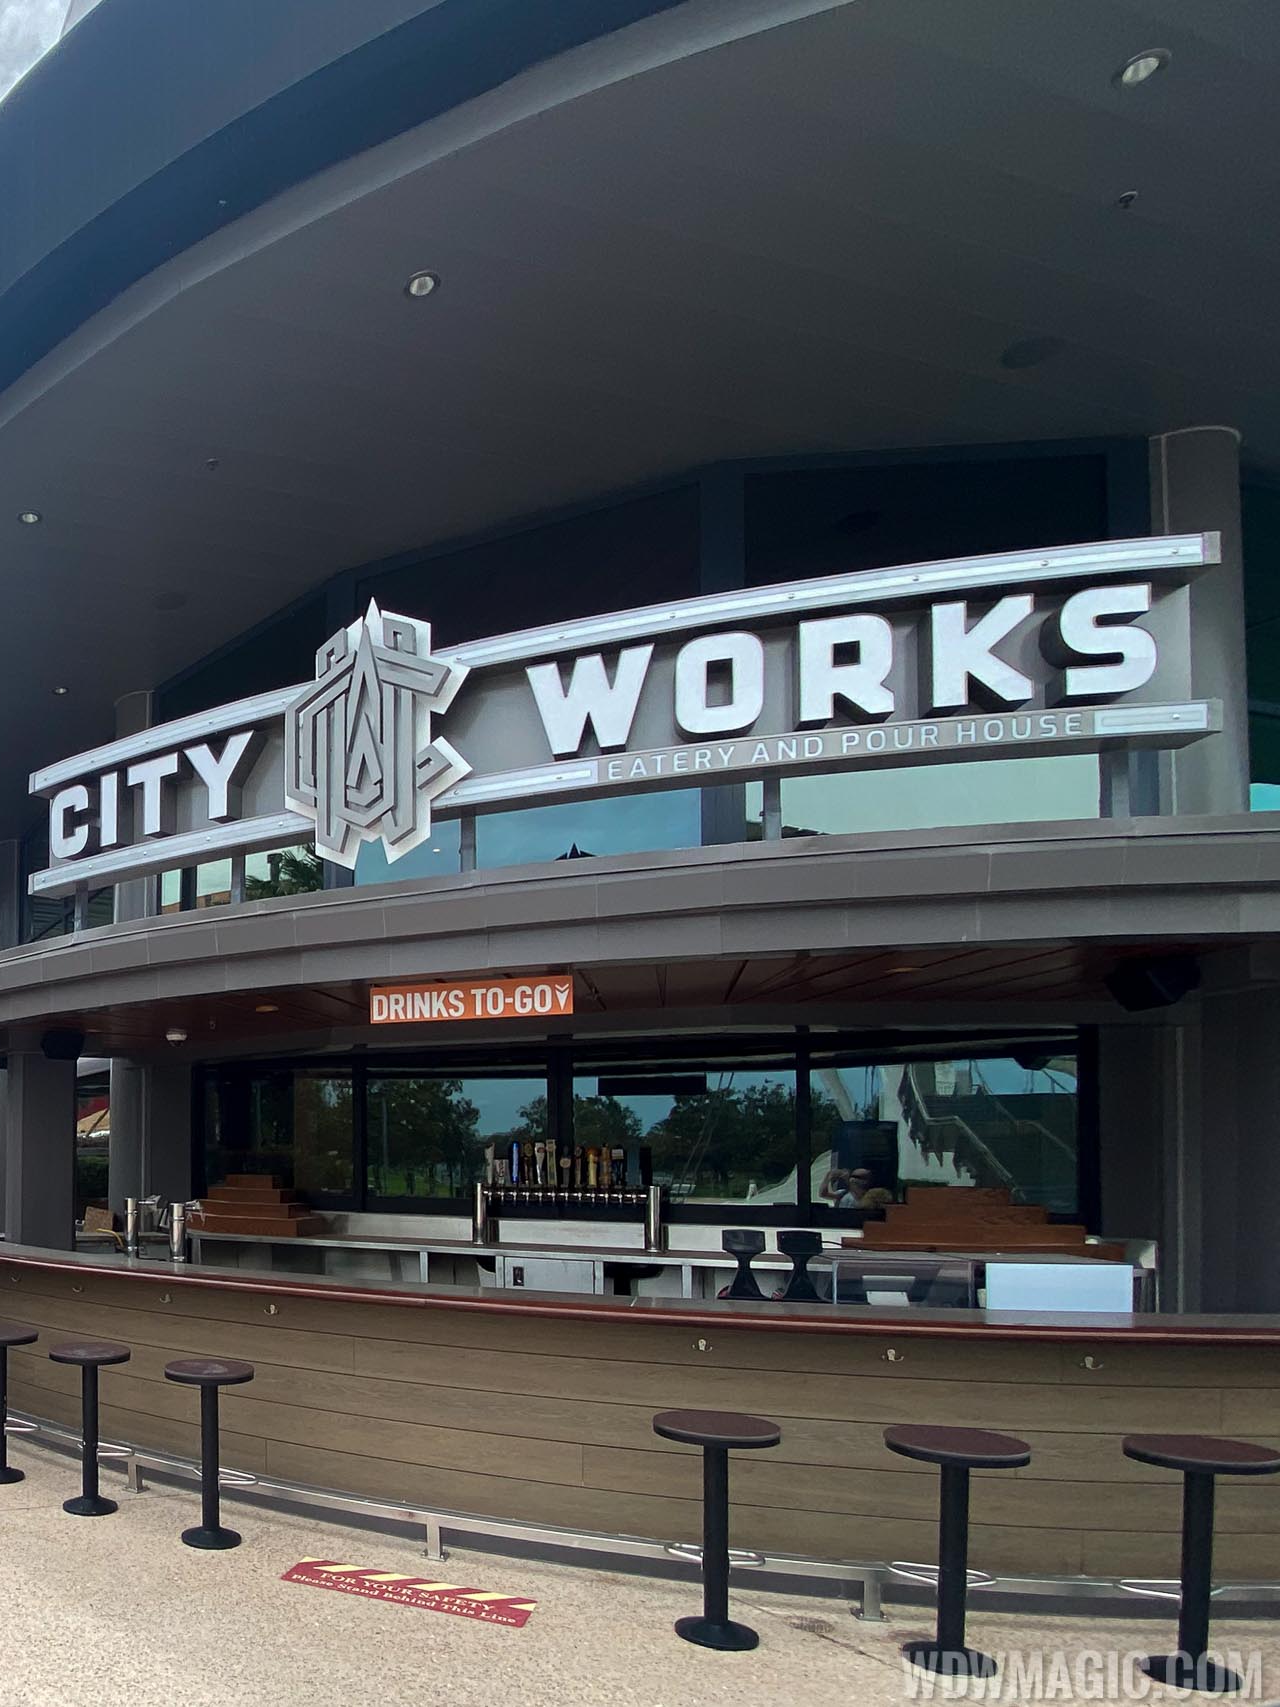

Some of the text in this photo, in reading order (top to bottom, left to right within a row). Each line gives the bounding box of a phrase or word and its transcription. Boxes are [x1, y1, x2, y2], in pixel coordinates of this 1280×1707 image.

[51, 582, 1159, 859] CITY WORKS
[607, 712, 1083, 780] EATERY AND POUR HOUSE
[372, 983, 553, 1021] DRINKS TO-GO
[291, 1573, 517, 1623] Please Stand Behind This Line
[320, 1572, 496, 1611] FOR YOUR SAFETY
